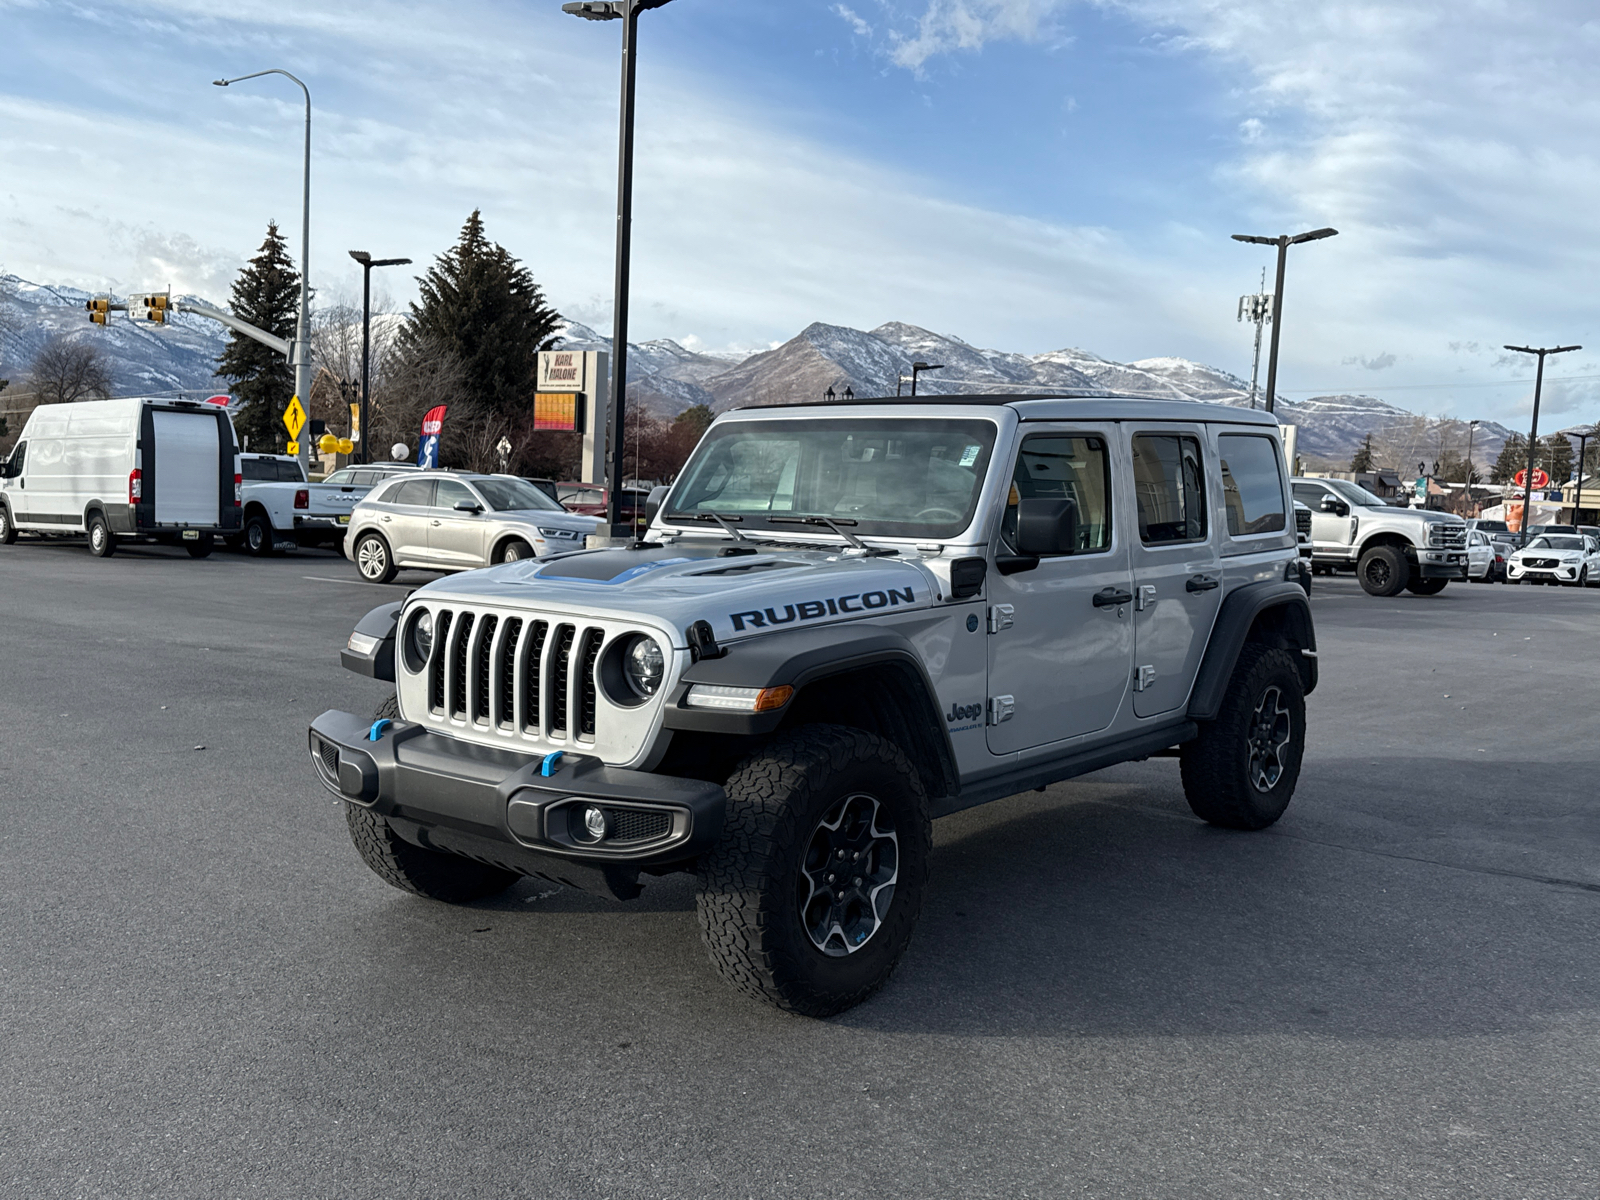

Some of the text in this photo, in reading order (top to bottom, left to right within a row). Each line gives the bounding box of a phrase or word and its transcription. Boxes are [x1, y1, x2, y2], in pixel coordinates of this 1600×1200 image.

[554, 354, 573, 366] KARL
[549, 368, 577, 381] MALONE
[424, 421, 441, 433] USED
[729, 586, 915, 632] RUBICON
[947, 703, 982, 722] Jeep
